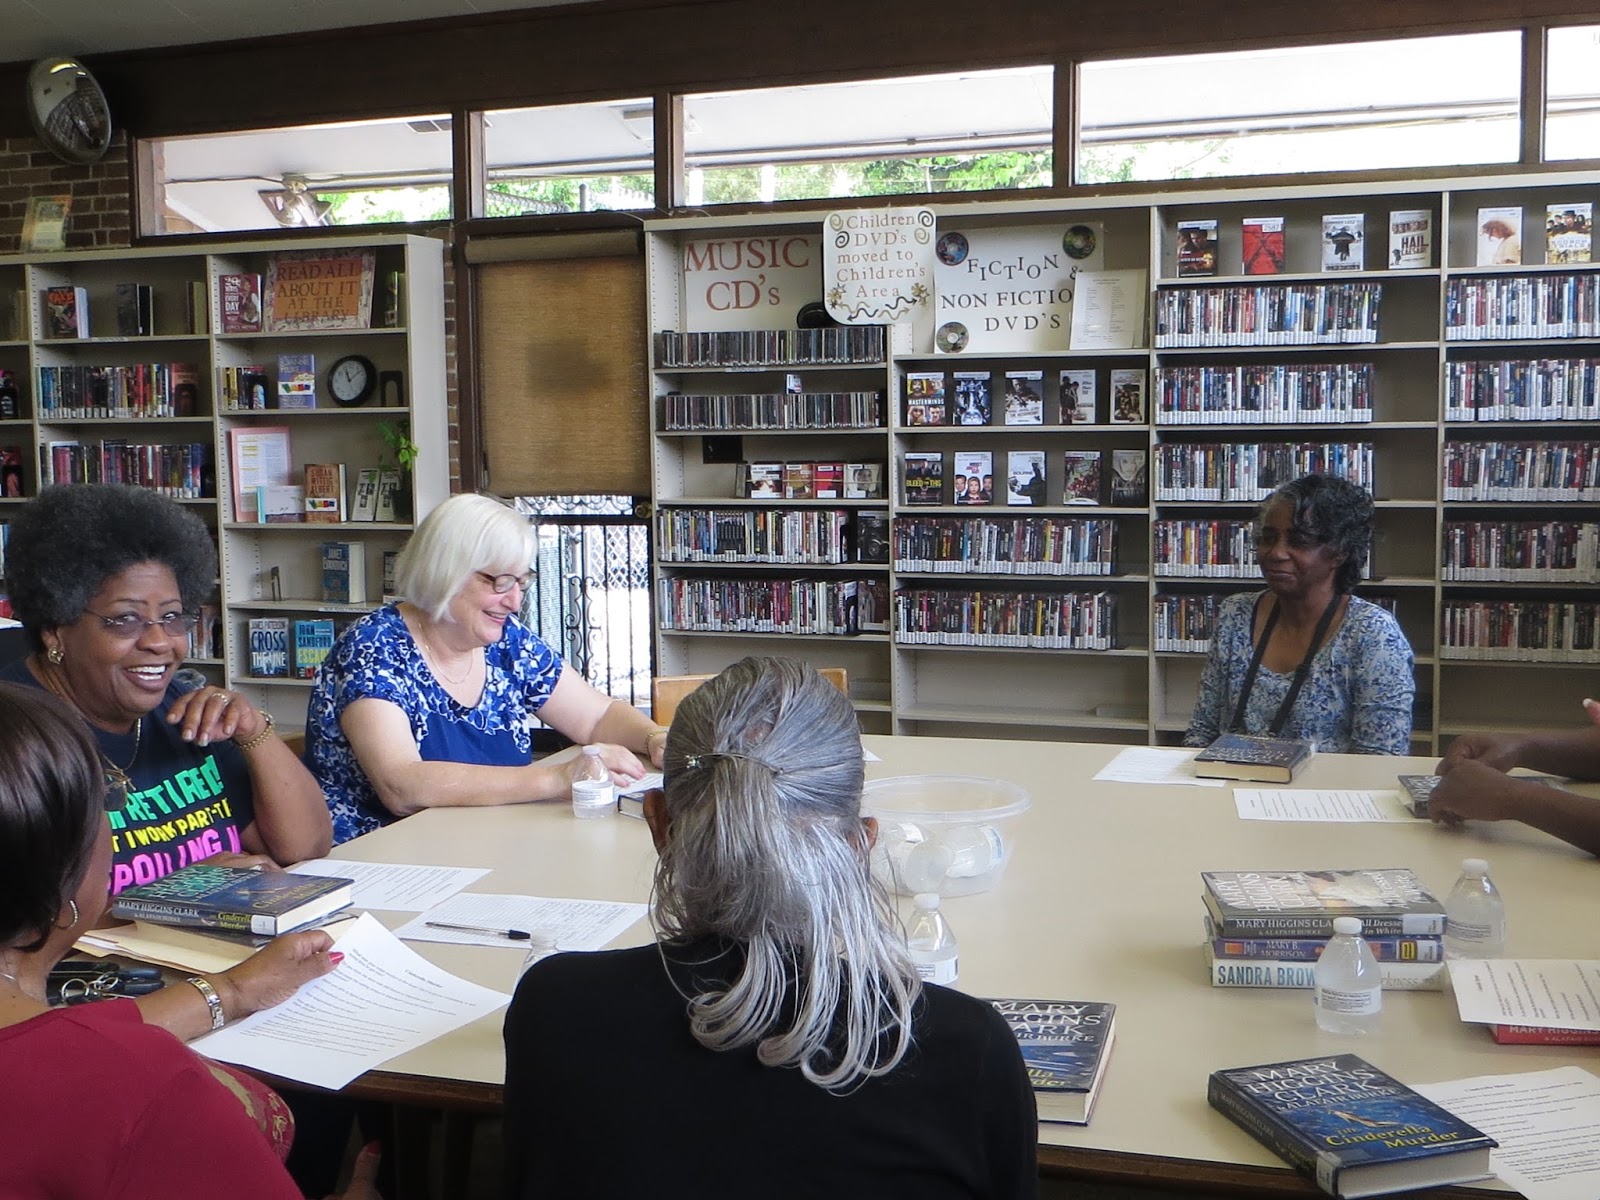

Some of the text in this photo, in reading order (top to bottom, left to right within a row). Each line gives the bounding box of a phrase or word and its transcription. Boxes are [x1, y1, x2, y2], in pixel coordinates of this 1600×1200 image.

[846, 213, 916, 230] Children
[854, 229, 908, 247] DVD's
[684, 237, 810, 272] MUSIC
[837, 249, 914, 264] moved to
[277, 262, 360, 281] READ ALL
[837, 262, 926, 283] Children's
[967, 254, 1060, 281] FICTION
[277, 281, 358, 298] ABOUT IT
[706, 274, 780, 311] CD's
[856, 285, 900, 298] Area
[941, 288, 1073, 309] NON FICTIO
[225, 301, 240, 311] DAY
[288, 296, 344, 309] AT THE
[284, 309, 350, 323] LIBRARY
[985, 313, 1061, 332] DVD'S
[908, 398, 945, 406] MASTERMINDS
[251, 631, 286, 651] CROSS
[133, 821, 178, 847] WORK
[118, 901, 200, 918] MARY HIGGINS CLARK
[217, 912, 251, 923] Cinderell
[1236, 919, 1333, 928] MARY HIGGINS CLA
[1373, 919, 1402, 927] Dresse
[1375, 927, 1402, 935] White
[1266, 940, 1290, 949] MARY
[1260, 950, 1306, 958] MORRISON
[1217, 965, 1315, 986] SANDRA BROW
[992, 1000, 1088, 1015] MARY
[1252, 1061, 1341, 1082] MARY
[1245, 1069, 1376, 1094] HIGGINS
[1274, 1080, 1380, 1102] CLARK
[1286, 1096, 1346, 1111] ALAFAIR
[1349, 1088, 1396, 1101] BURKE
[1326, 1126, 1432, 1146] Cinderella
[1384, 1131, 1460, 1149] Murder
